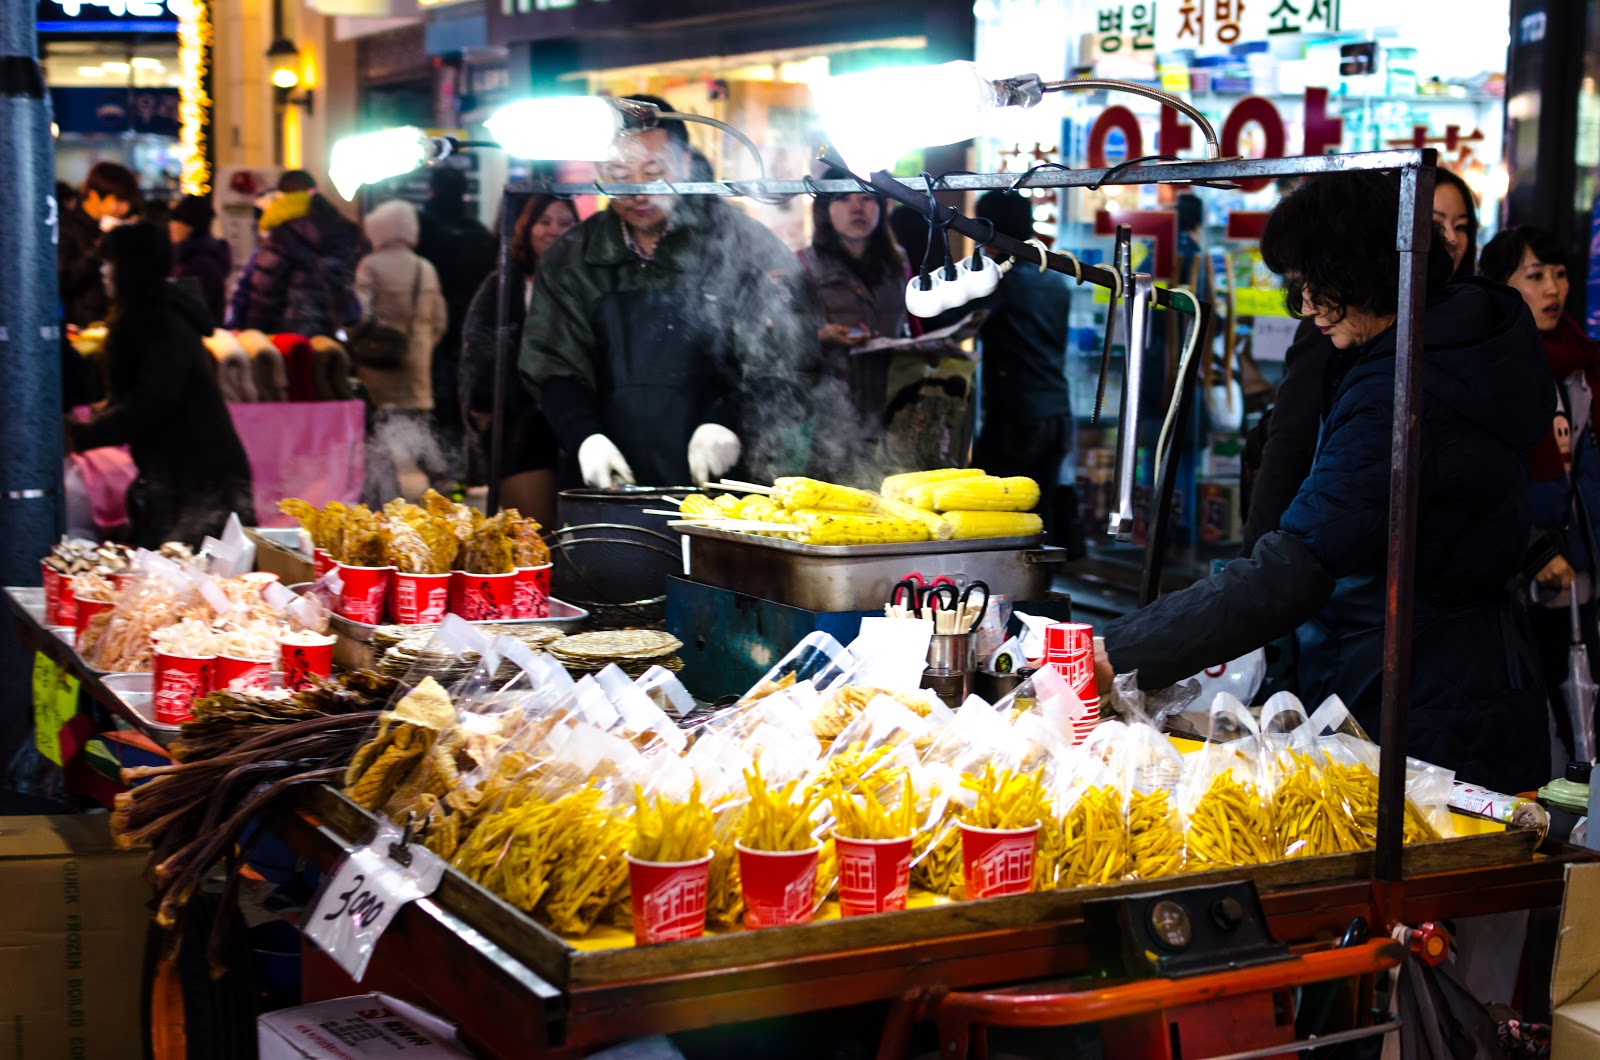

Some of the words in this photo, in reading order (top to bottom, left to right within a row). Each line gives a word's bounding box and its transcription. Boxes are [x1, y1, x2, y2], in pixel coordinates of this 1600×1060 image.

[1098, 4, 1156, 53] 병원
[1177, 0, 1245, 45] 처방
[63, 860, 81, 904] QUICK
[65, 914, 82, 970] FROZEN
[67, 979, 84, 1028] BOILED
